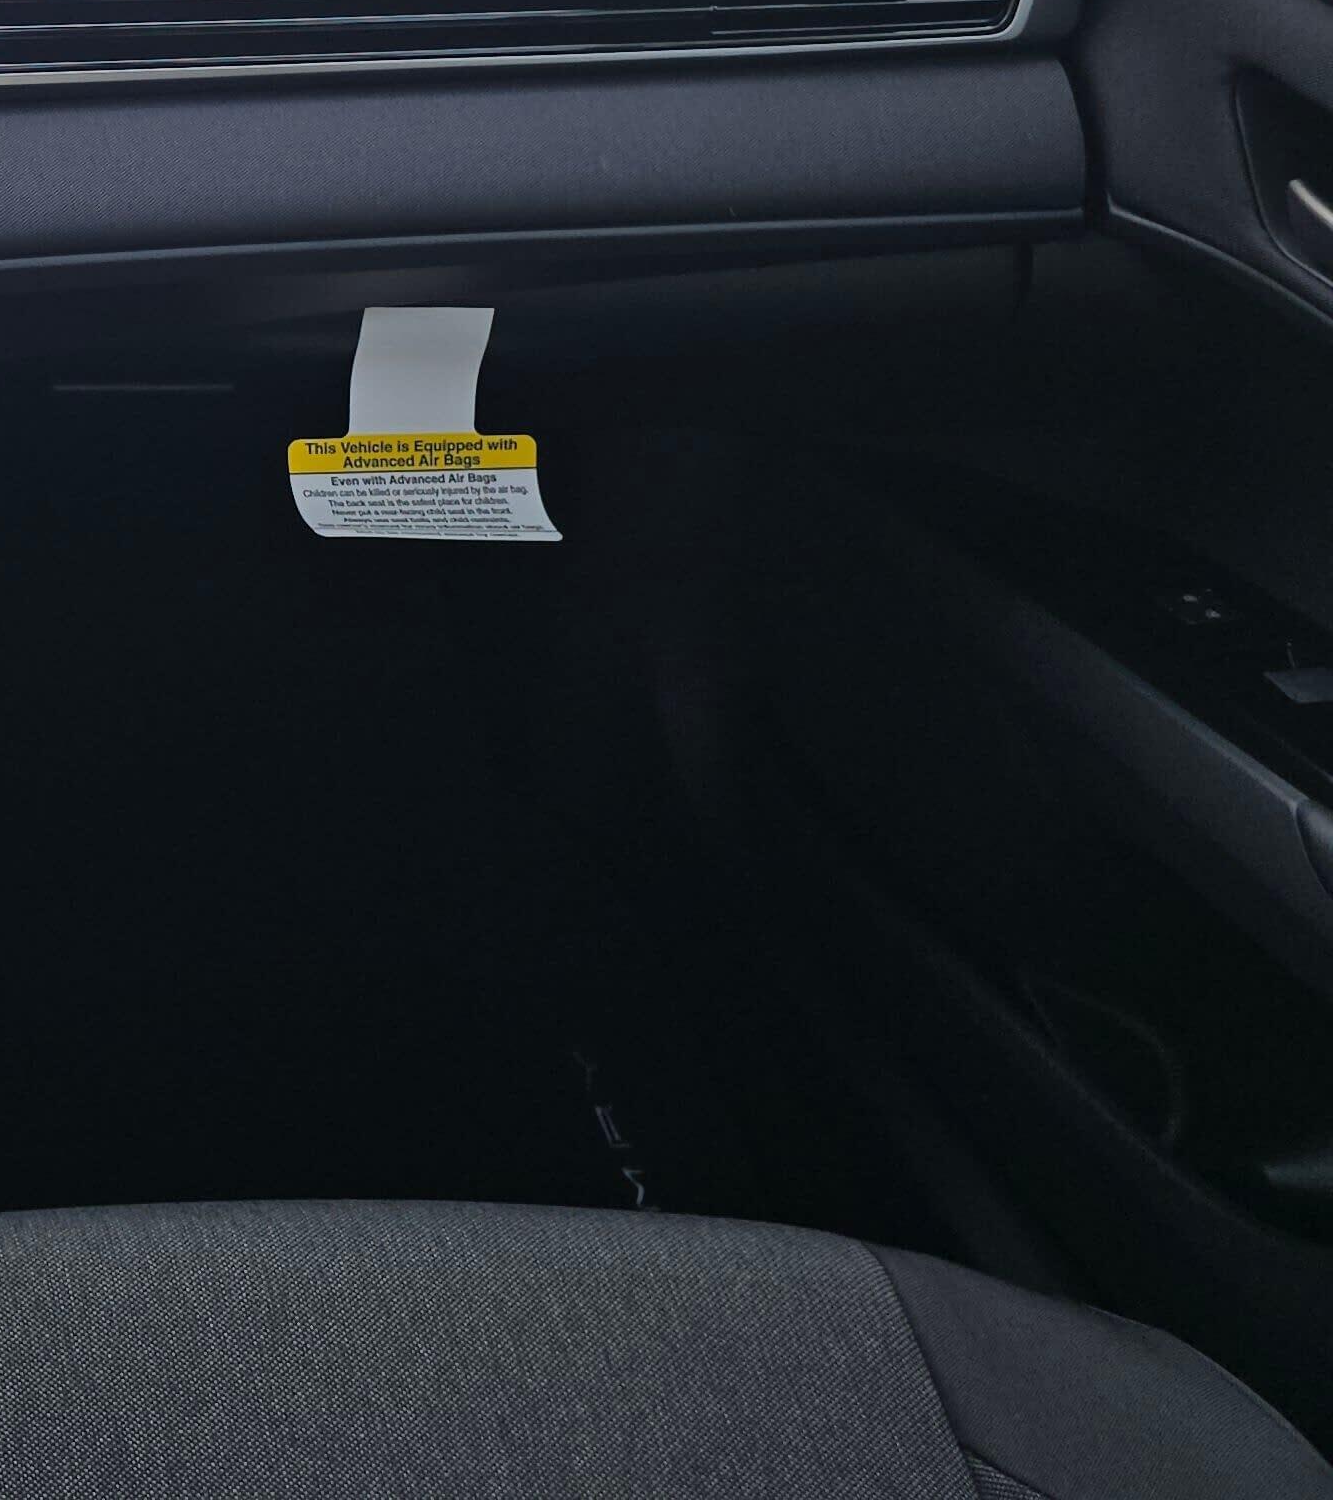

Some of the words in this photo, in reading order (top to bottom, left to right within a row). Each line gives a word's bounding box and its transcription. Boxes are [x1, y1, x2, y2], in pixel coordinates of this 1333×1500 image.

[306, 442, 336, 454] This
[341, 441, 393, 453] Vehicle
[397, 441, 409, 452] is
[414, 439, 483, 453] Equipped
[487, 438, 518, 451] with
[343, 456, 415, 468] Advanced
[418, 454, 440, 466] Air
[444, 453, 481, 468] Bags
[330, 477, 360, 486] Even
[362, 475, 387, 485] with
[389, 474, 445, 485] Advanced
[448, 473, 465, 483] Air
[468, 472, 497, 484] Bags
[303, 489, 338, 498] Children
[356, 489, 367, 497] be
[369, 488, 391, 496] killed
[471, 486, 481, 496] by
[483, 486, 496, 494] the
